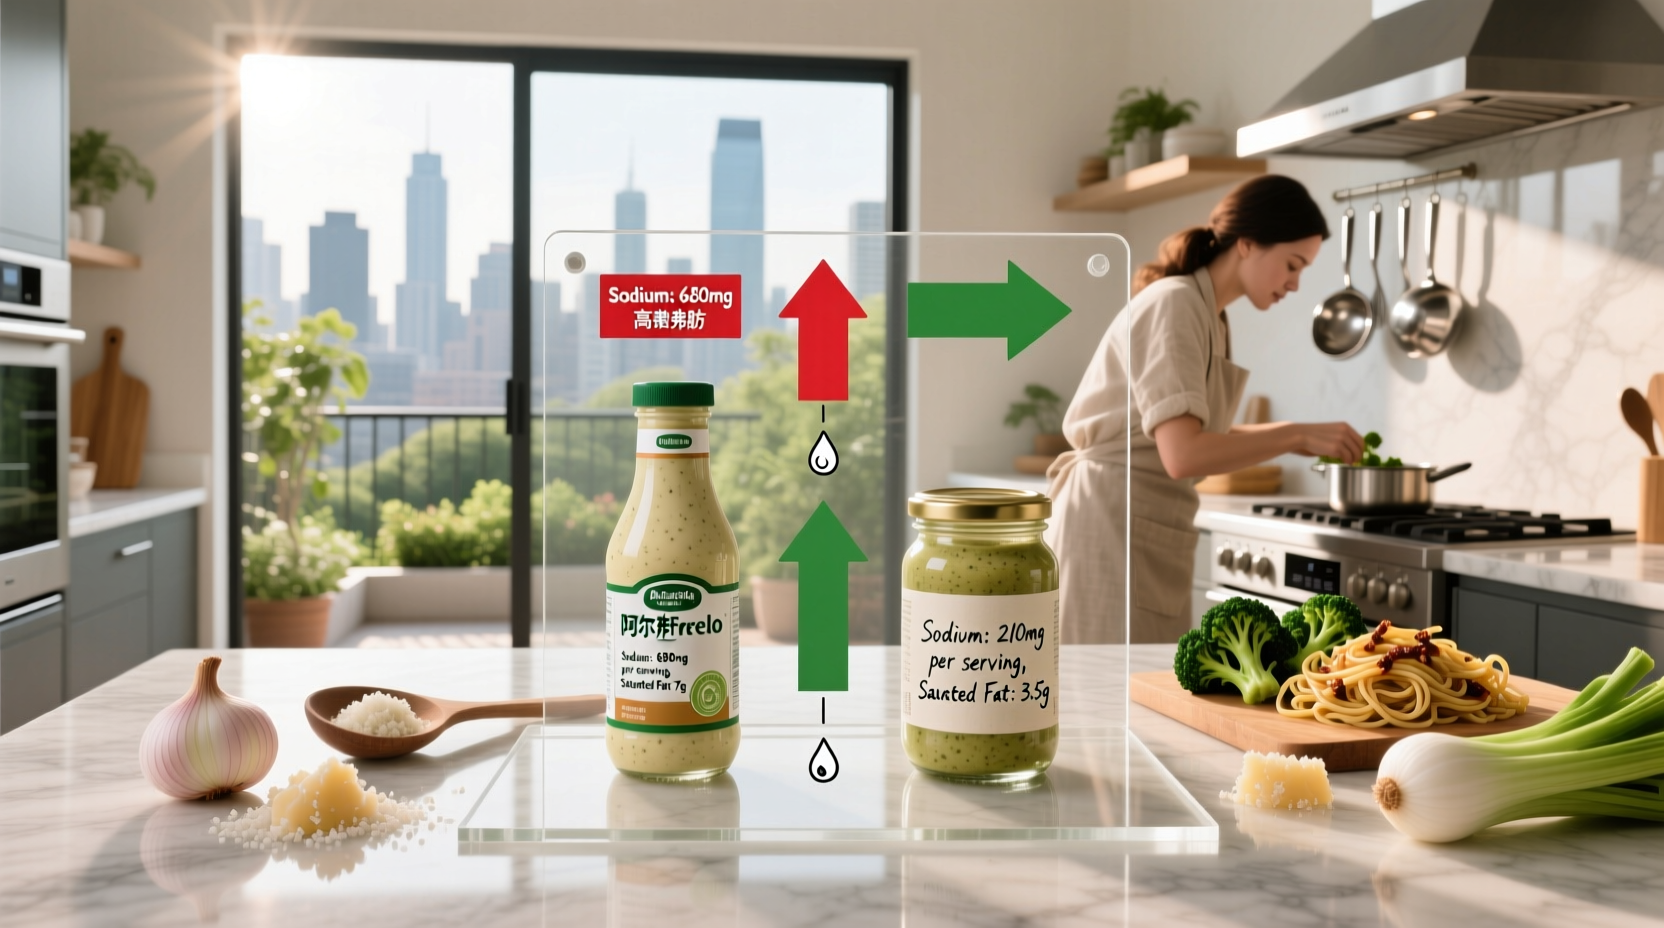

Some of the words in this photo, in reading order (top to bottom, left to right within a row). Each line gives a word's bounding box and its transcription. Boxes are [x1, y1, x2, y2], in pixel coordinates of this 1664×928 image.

[608, 286, 675, 304] Sodium:
[679, 286, 733, 309] 680mg
[921, 619, 989, 644] Sodium:
[928, 655, 956, 678] per
[961, 654, 1026, 679] serving,
[984, 681, 1016, 703] Fat:
[1020, 680, 1050, 709] 3.5g
